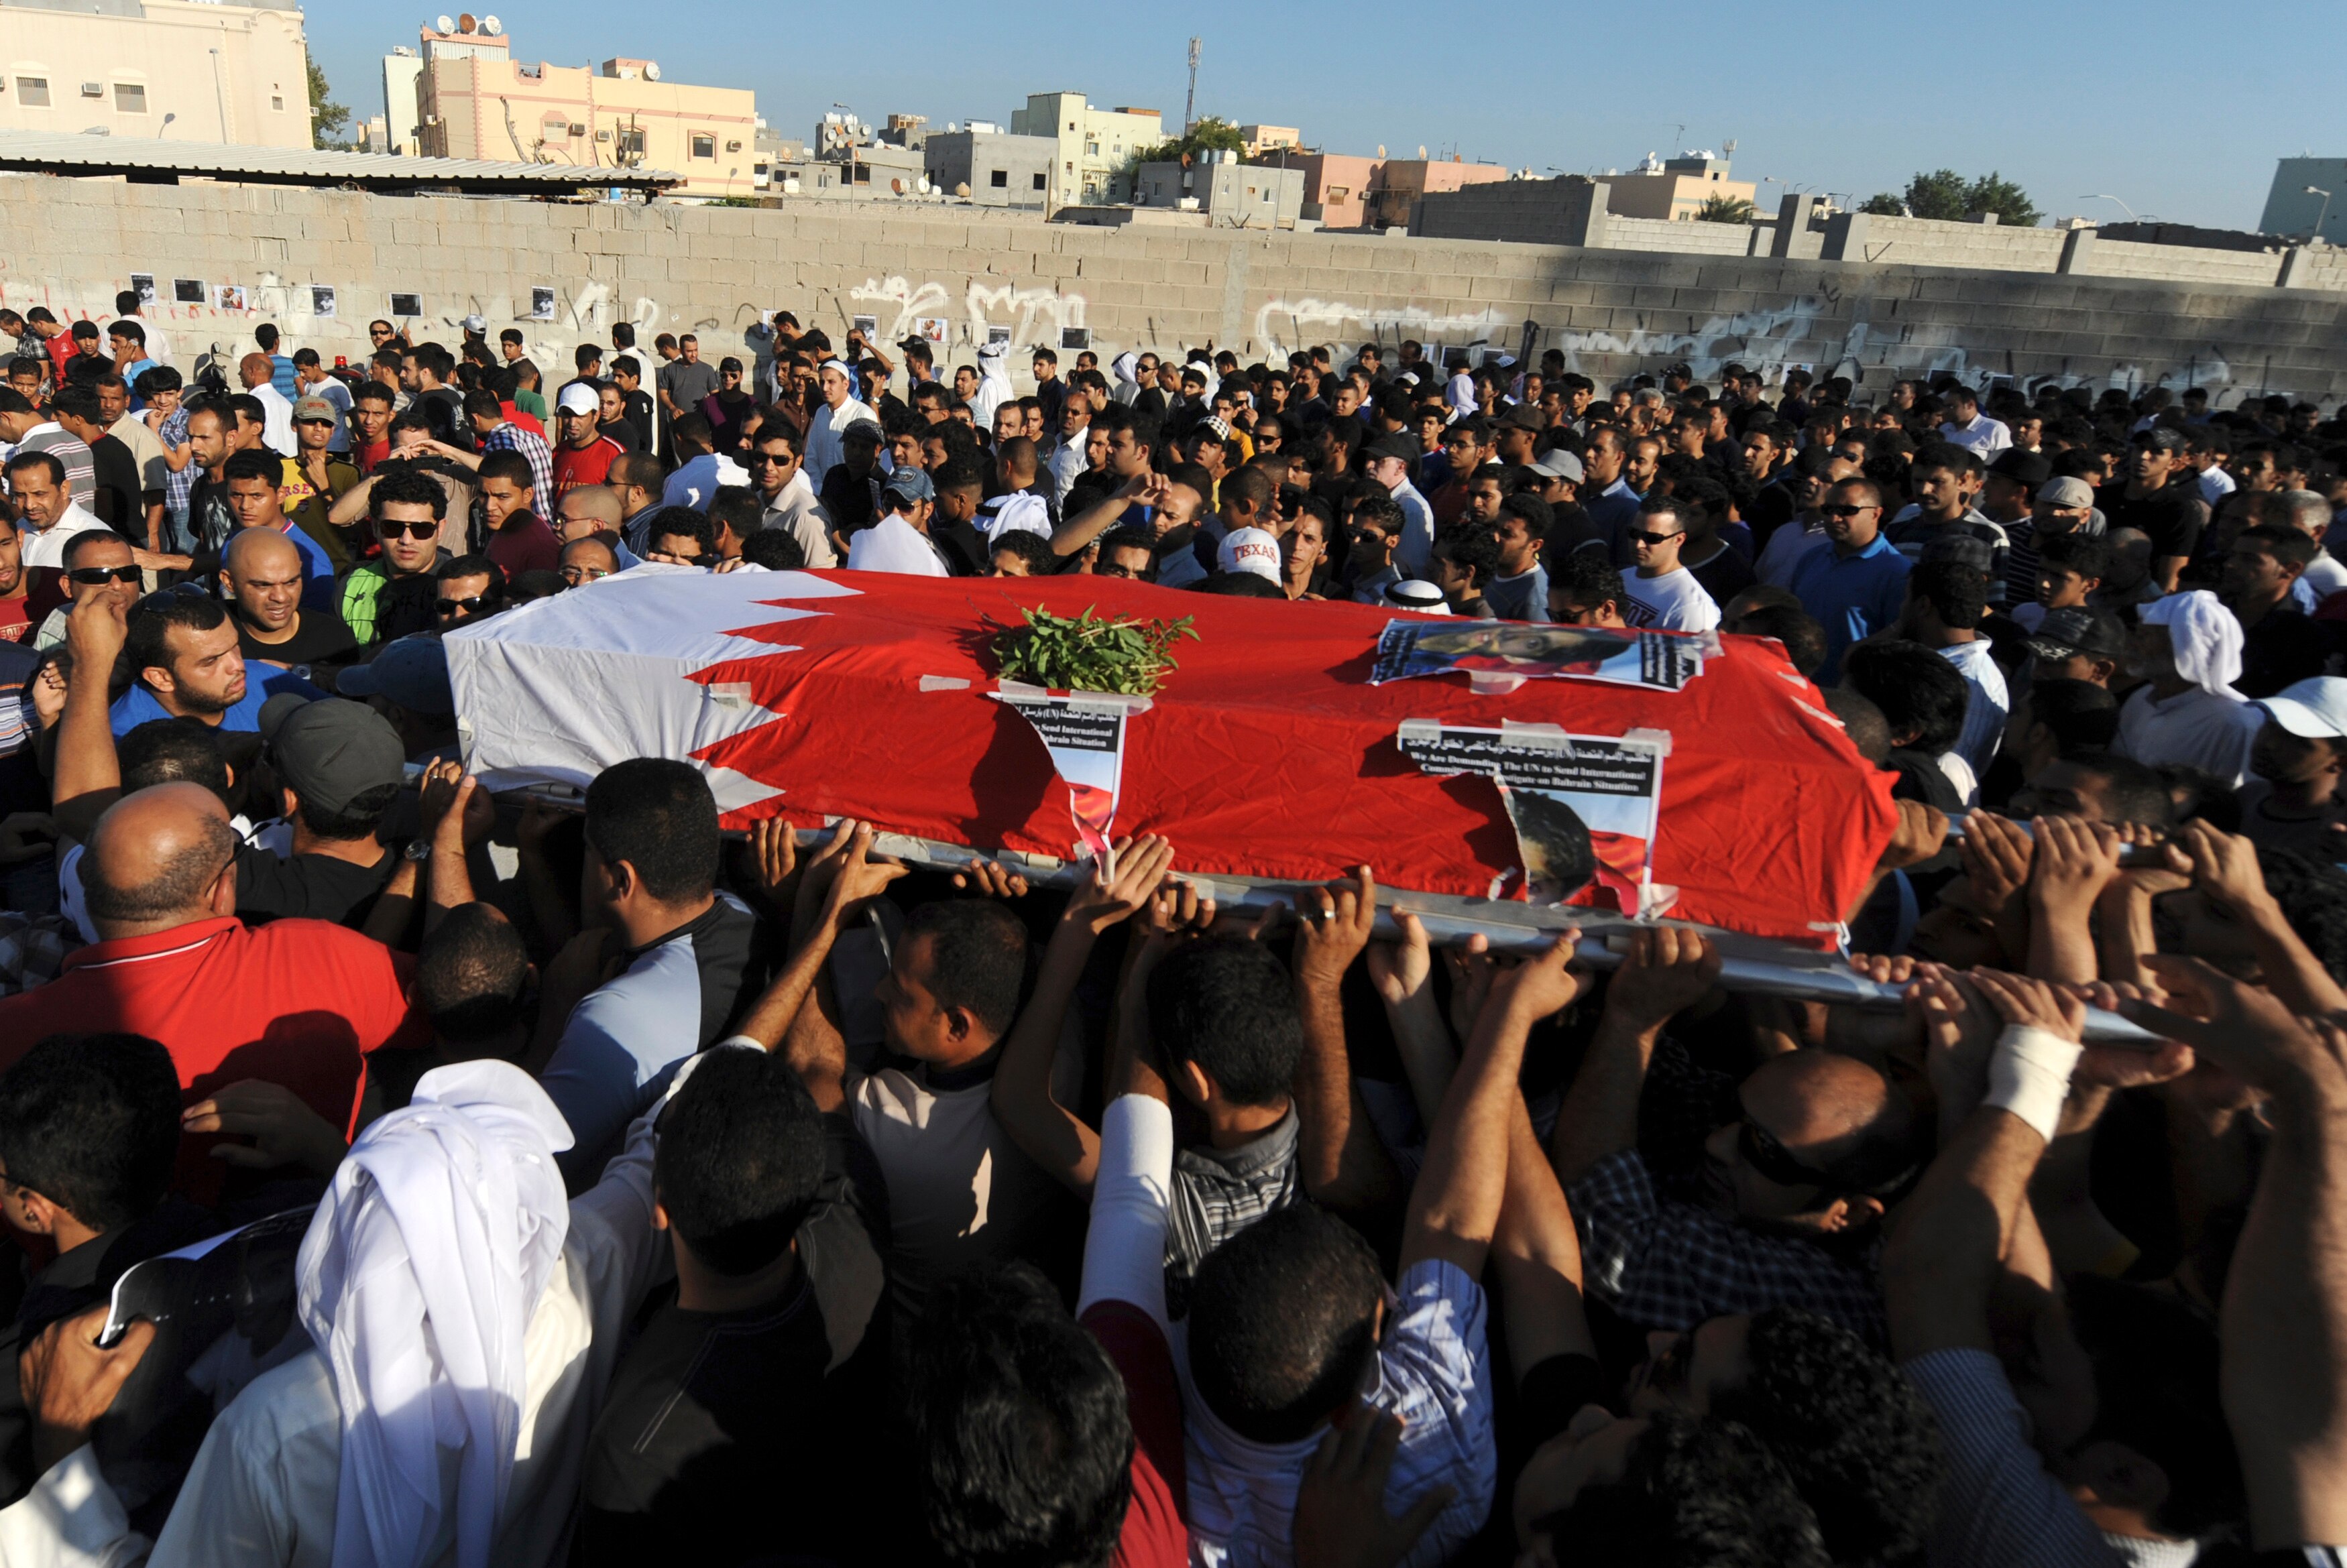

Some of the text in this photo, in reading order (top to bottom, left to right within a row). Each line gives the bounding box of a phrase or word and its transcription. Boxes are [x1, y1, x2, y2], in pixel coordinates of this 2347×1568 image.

[1233, 544, 1277, 564] TEXAS
[1041, 723, 1061, 733] Send
[1062, 725, 1113, 737] International
[1071, 737, 1107, 747] Situation
[1410, 751, 1647, 780] We Are Demanding The UN to Send International
[1551, 776, 1593, 789] Bahrain
[1593, 780, 1640, 792] Situation
